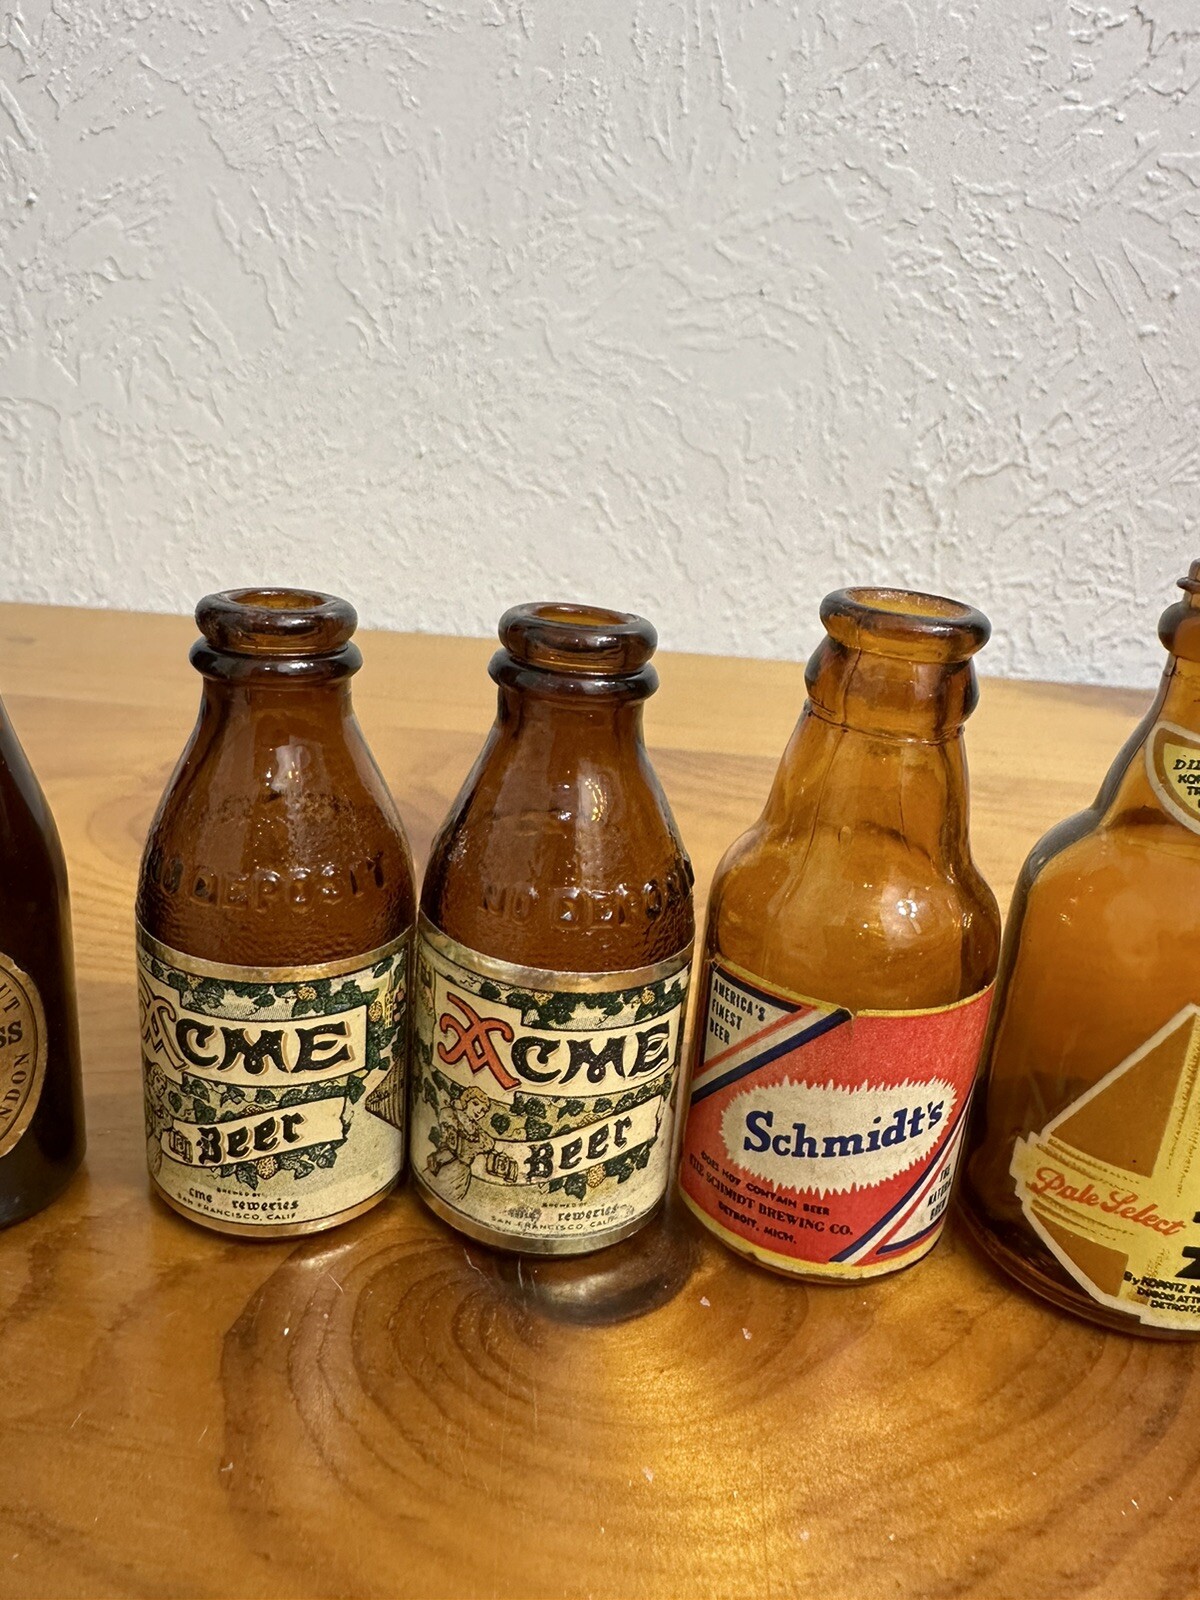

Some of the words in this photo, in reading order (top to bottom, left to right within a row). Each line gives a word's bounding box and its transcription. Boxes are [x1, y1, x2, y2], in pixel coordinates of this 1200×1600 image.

[711, 998, 743, 1031] FINEST
[714, 978, 766, 1022] AMERICA'S
[436, 991, 671, 1091] ACME
[709, 1017, 730, 1045] BEER
[198, 1111, 305, 1165] Beer
[525, 1114, 633, 1182] Beer
[743, 1099, 945, 1159] Schmidt's
[689, 1153, 704, 1177] THE
[706, 1172, 757, 1209] SCHMIDT
[758, 1203, 825, 1232] BREWING
[829, 1223, 853, 1235] CO.
[701, 1150, 719, 1172] DOES
[722, 1168, 741, 1186] NOT
[746, 1182, 797, 1209] CONTAIN
[803, 1203, 830, 1216] BEER
[1030, 1166, 1101, 1207] Pale
[1100, 1190, 1187, 1236] Select
[764, 1226, 797, 1244] MICH.
[1123, 1270, 1140, 1285] By
